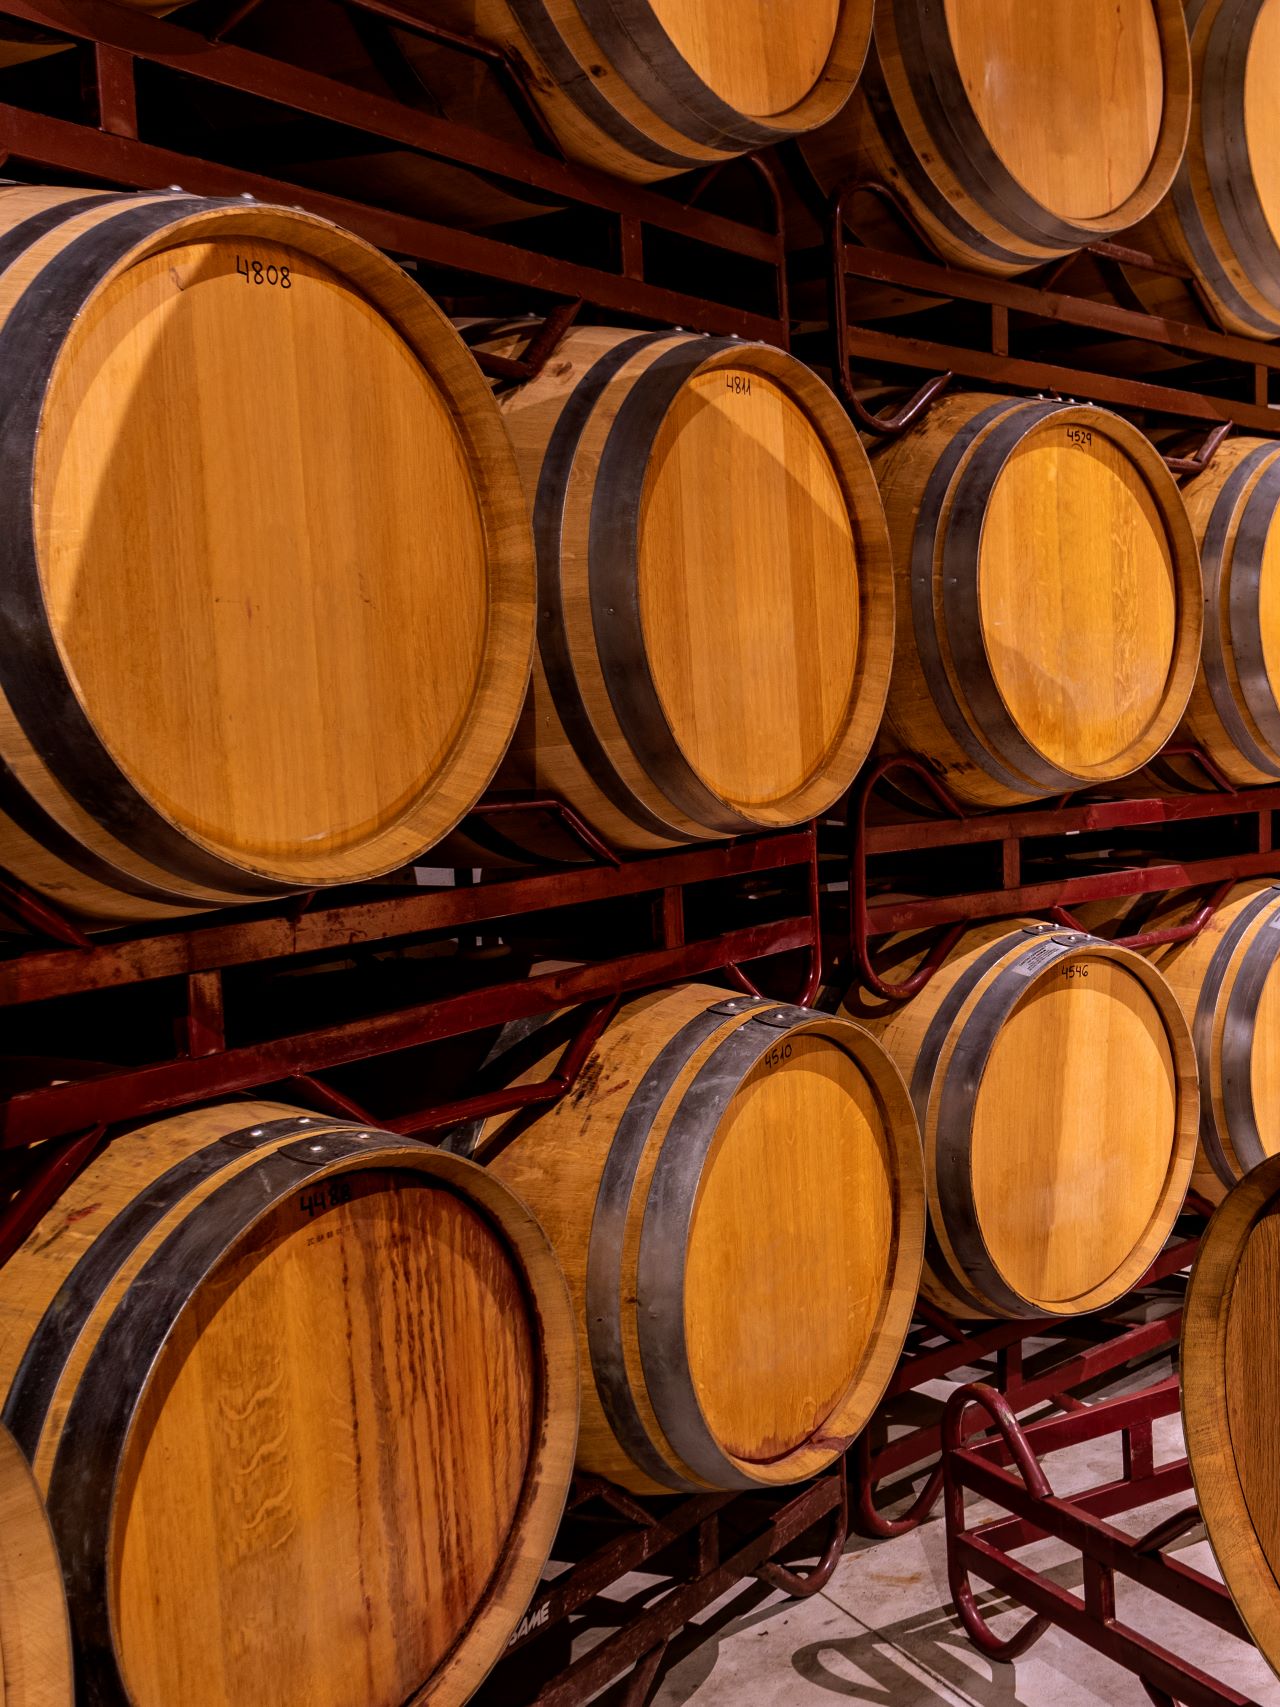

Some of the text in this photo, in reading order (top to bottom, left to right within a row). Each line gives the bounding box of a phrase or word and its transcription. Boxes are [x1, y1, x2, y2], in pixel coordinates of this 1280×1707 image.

[236, 255, 292, 289] 4808
[1066, 428, 1092, 447] 4529
[1062, 964, 1089, 979] 4546
[765, 1044, 792, 1069] 4510
[300, 1184, 351, 1216] 4488
